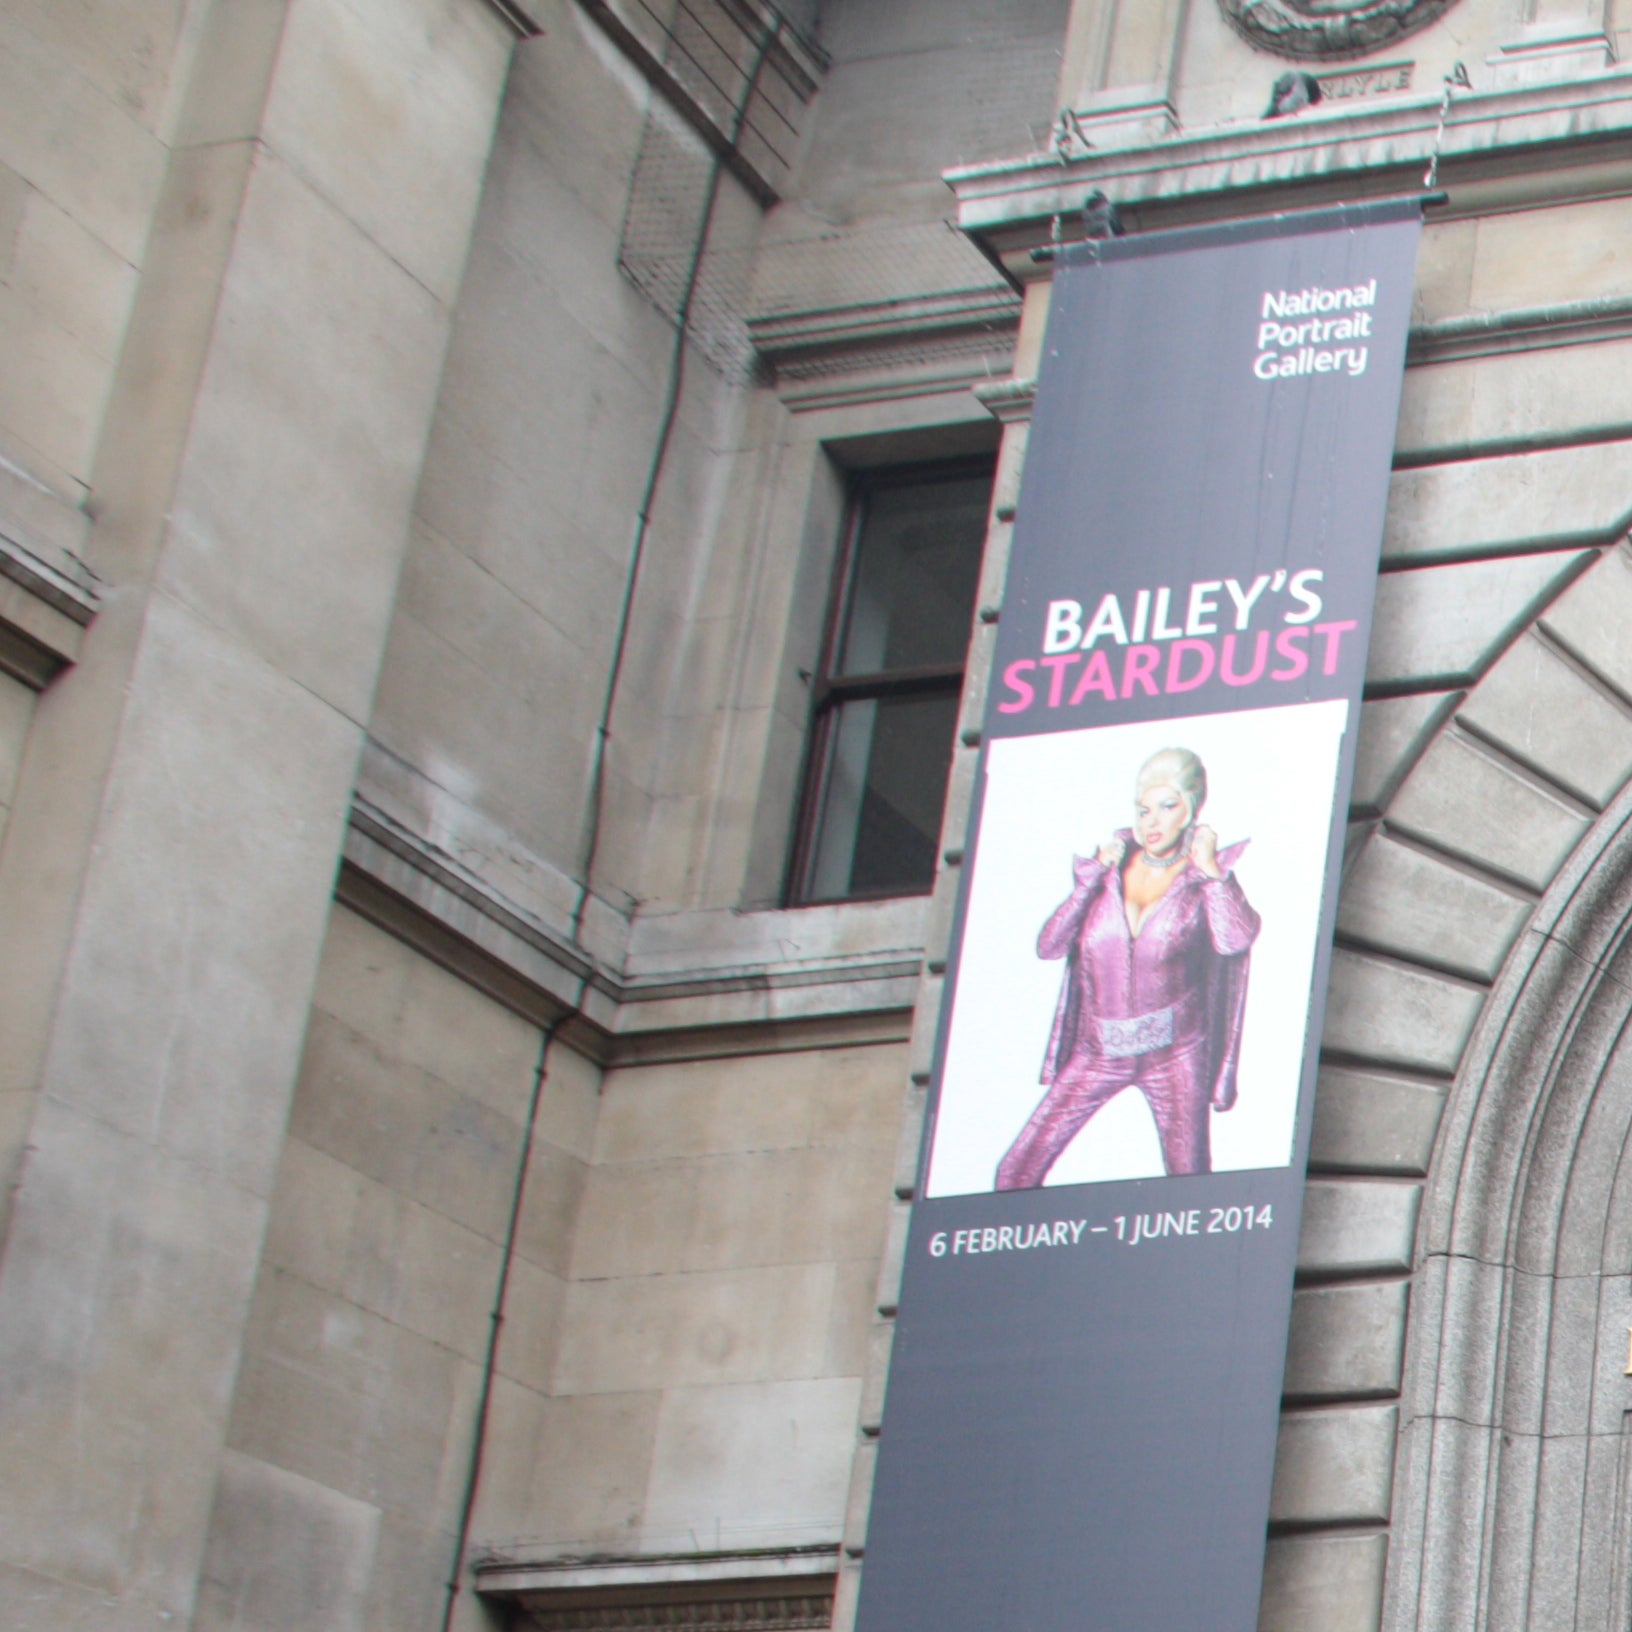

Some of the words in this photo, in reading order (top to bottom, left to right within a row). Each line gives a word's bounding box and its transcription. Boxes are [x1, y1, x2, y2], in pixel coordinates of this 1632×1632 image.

[1261, 279, 1376, 317] National
[1257, 312, 1372, 349] Portrait
[1254, 345, 1368, 380] Gallery
[1042, 568, 1324, 655] BAILEY'S
[998, 620, 1357, 714] STARDUST
[929, 1231, 948, 1257] 6
[953, 1219, 1087, 1256] FEBRUARY
[1114, 1216, 1126, 1241] 1
[1129, 1210, 1200, 1246] JUNE
[1207, 1204, 1274, 1234] 2014
